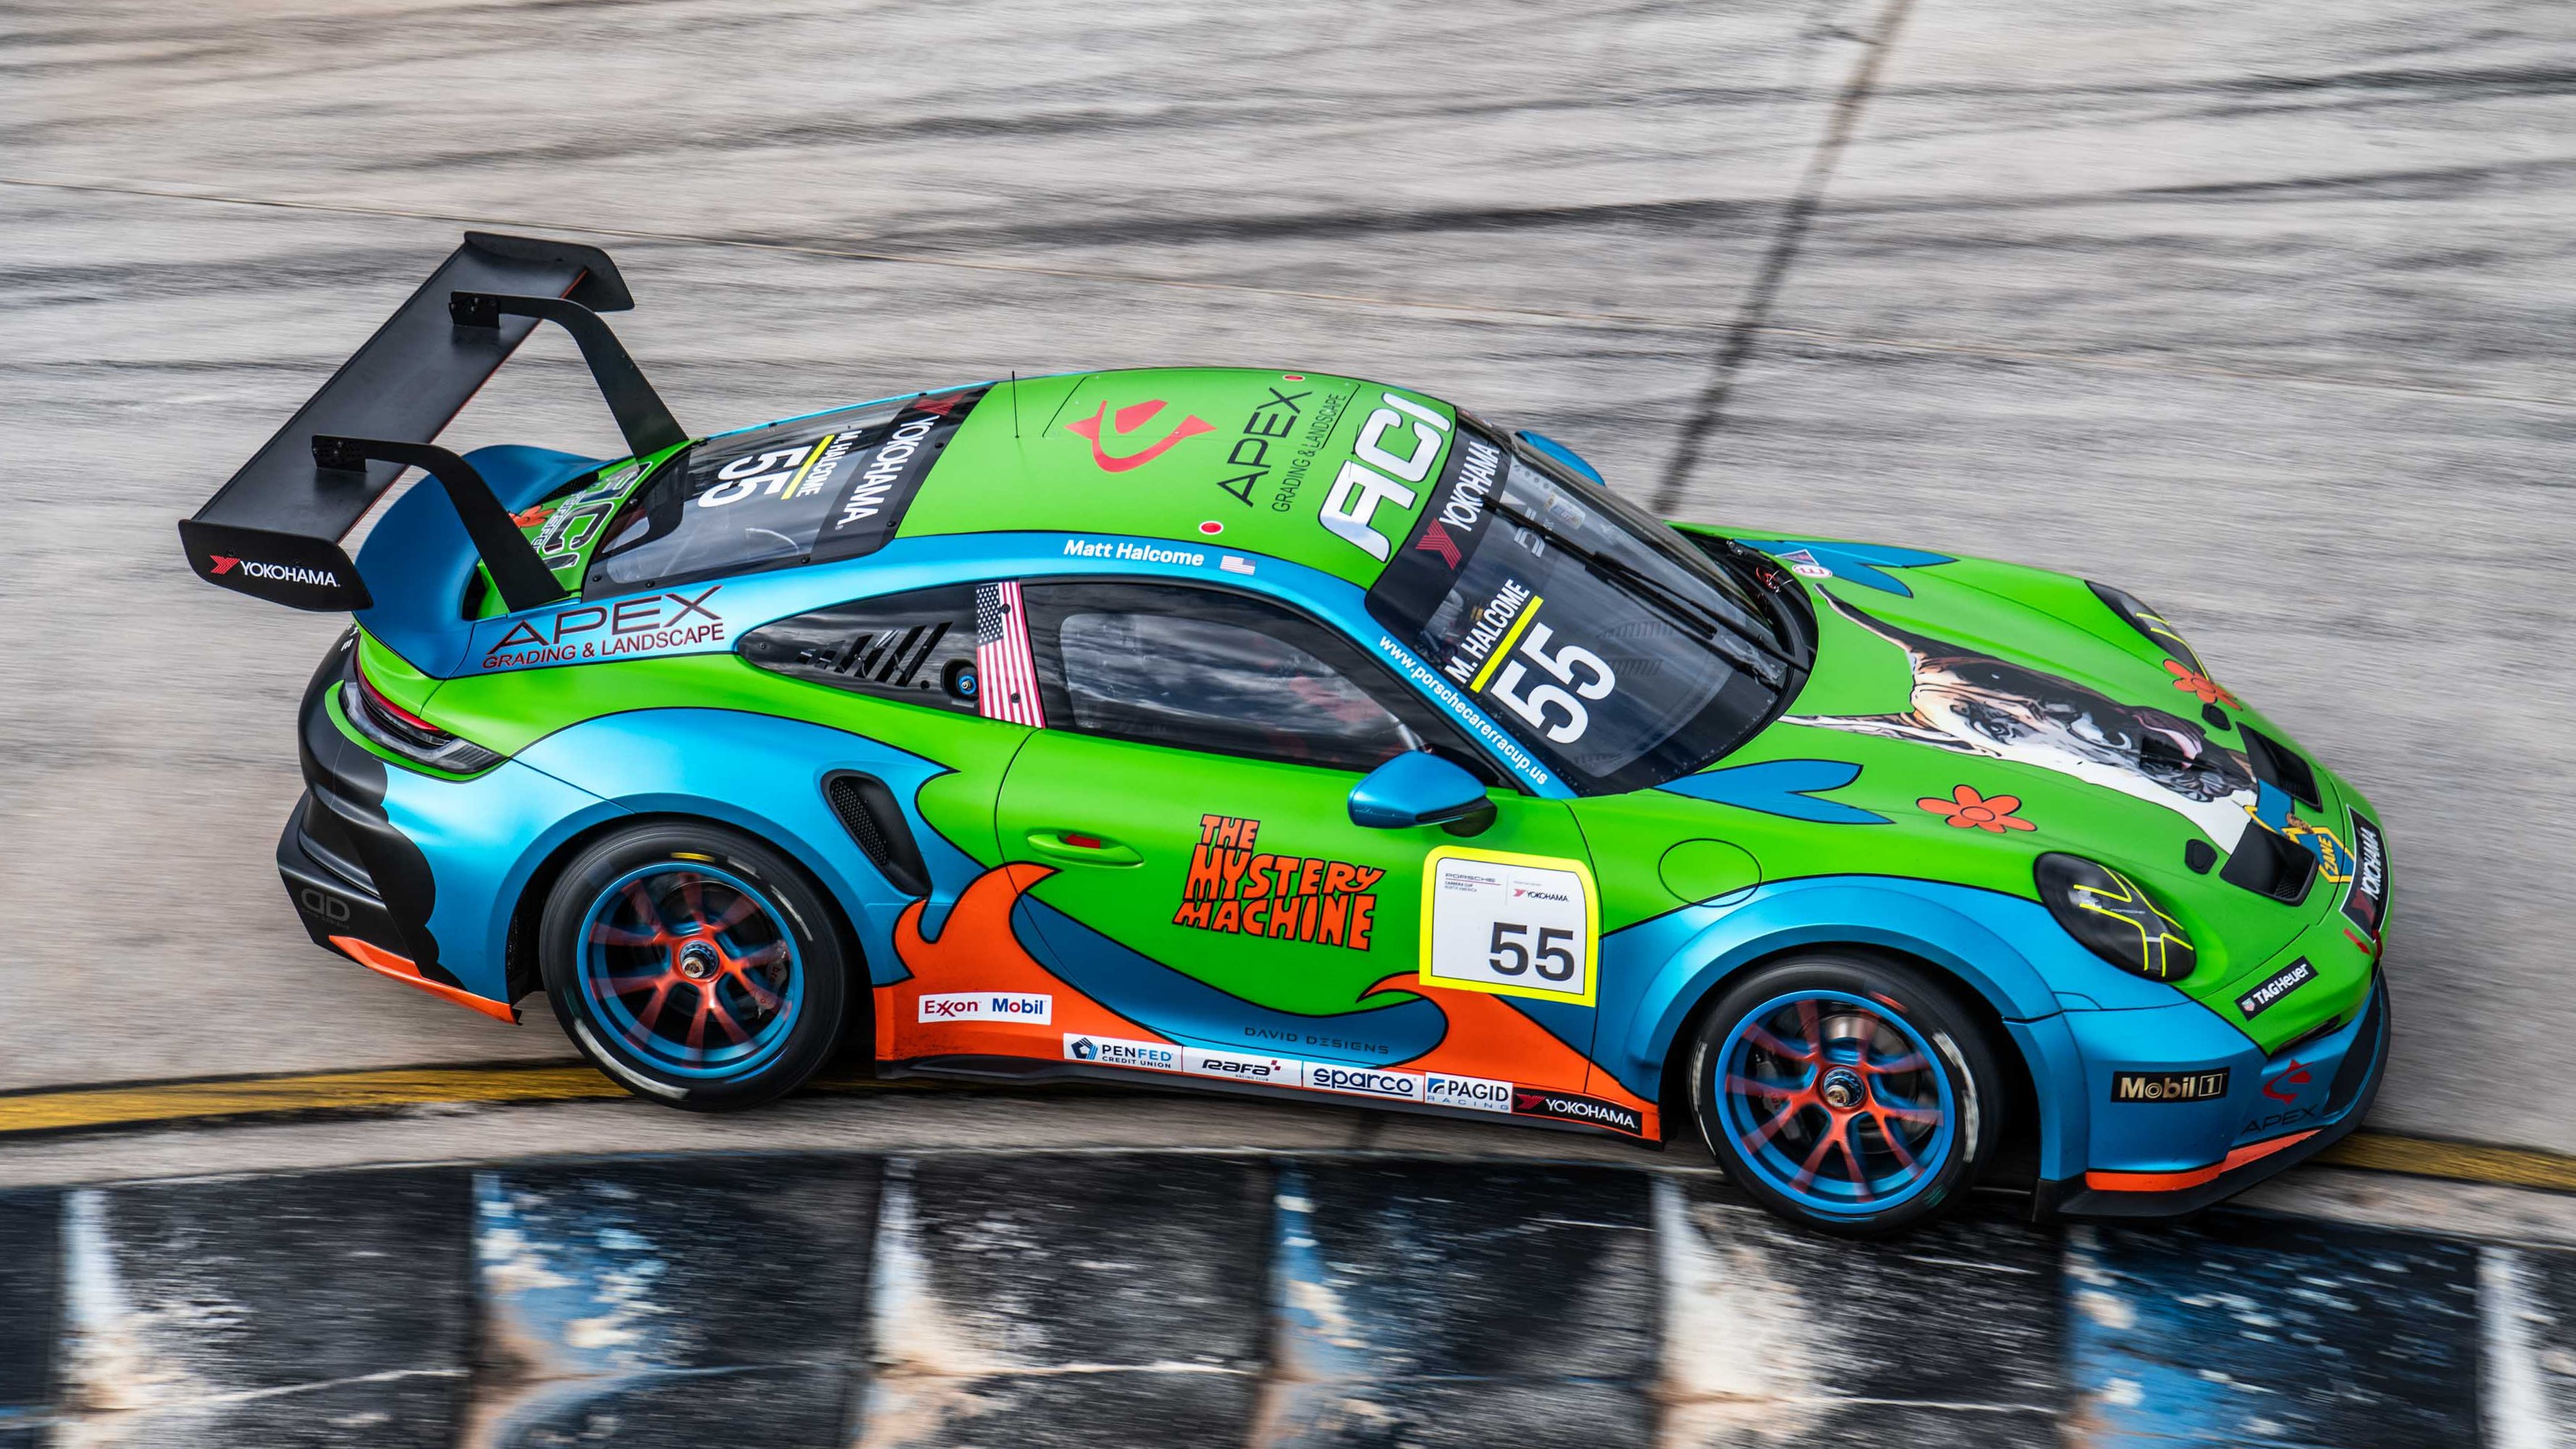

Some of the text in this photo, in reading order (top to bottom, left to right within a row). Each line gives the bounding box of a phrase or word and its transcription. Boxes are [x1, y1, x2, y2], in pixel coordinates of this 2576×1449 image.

[796, 442, 853, 497] HALCOME
[836, 414, 940, 526] YOKOHAMA
[1216, 387, 1313, 508] APEX
[1271, 458, 1311, 512] GRADING
[1301, 393, 1347, 450] LANDSCAPE
[698, 445, 812, 508] 55
[1318, 392, 1451, 563] ACI
[1439, 440, 1501, 532] YOKOHAMA
[240, 560, 337, 587] YOKOHAMA
[1063, 539, 1204, 566] Matt Halcome
[487, 585, 723, 655] APEX
[1444, 579, 1530, 684] M. HALCOME
[482, 622, 725, 669] GRADING & LANDSCAPE
[1490, 621, 1616, 744] 55
[1379, 636, 1549, 786] www.porschecarerracup.us
[1200, 813, 1260, 850] THE
[2318, 834, 2339, 875] ZANE
[1183, 842, 1386, 902] MYSTERY
[2360, 826, 2382, 901] YOKOHAMA
[1526, 891, 1569, 902] YOKOHAMA
[1171, 894, 1378, 952] MACHINE
[1489, 921, 1575, 982] 55
[924, 998, 1043, 1017] Exxon Mobil
[1102, 1044, 1172, 1062] PENFED
[1102, 1056, 1137, 1064] CREDIT
[1245, 1027, 1389, 1055] DAVID DESIGNS
[1313, 1068, 1413, 1093] sparco
[1427, 1096, 1510, 1111] RACING
[1448, 1080, 1510, 1102] PAGID
[2119, 1077, 2196, 1099] Mobil
[1545, 1098, 1636, 1129] YOKOHAMA
[2241, 1104, 2318, 1135] APEX
